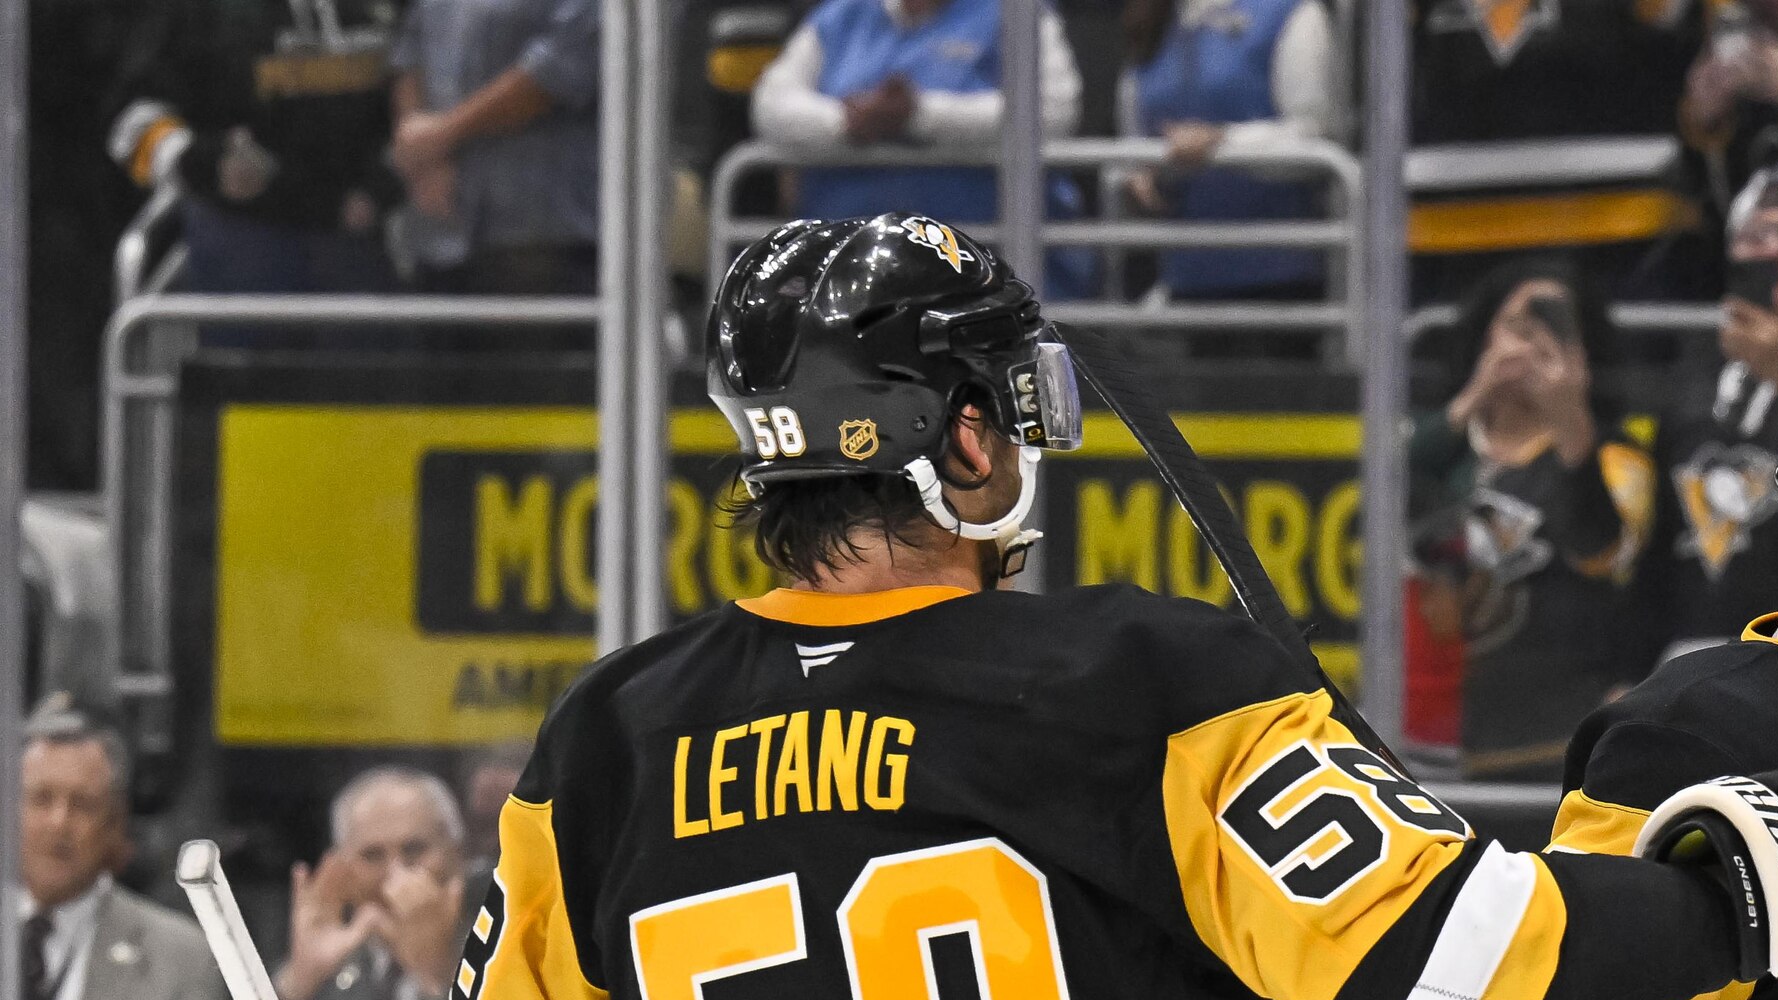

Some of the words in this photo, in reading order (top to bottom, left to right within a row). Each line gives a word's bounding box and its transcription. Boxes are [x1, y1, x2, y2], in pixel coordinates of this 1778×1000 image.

[744, 406, 807, 459] 58
[674, 709, 915, 839] LETANG
[1216, 738, 1471, 906] 58
[1733, 855, 1758, 928] LEGEND
